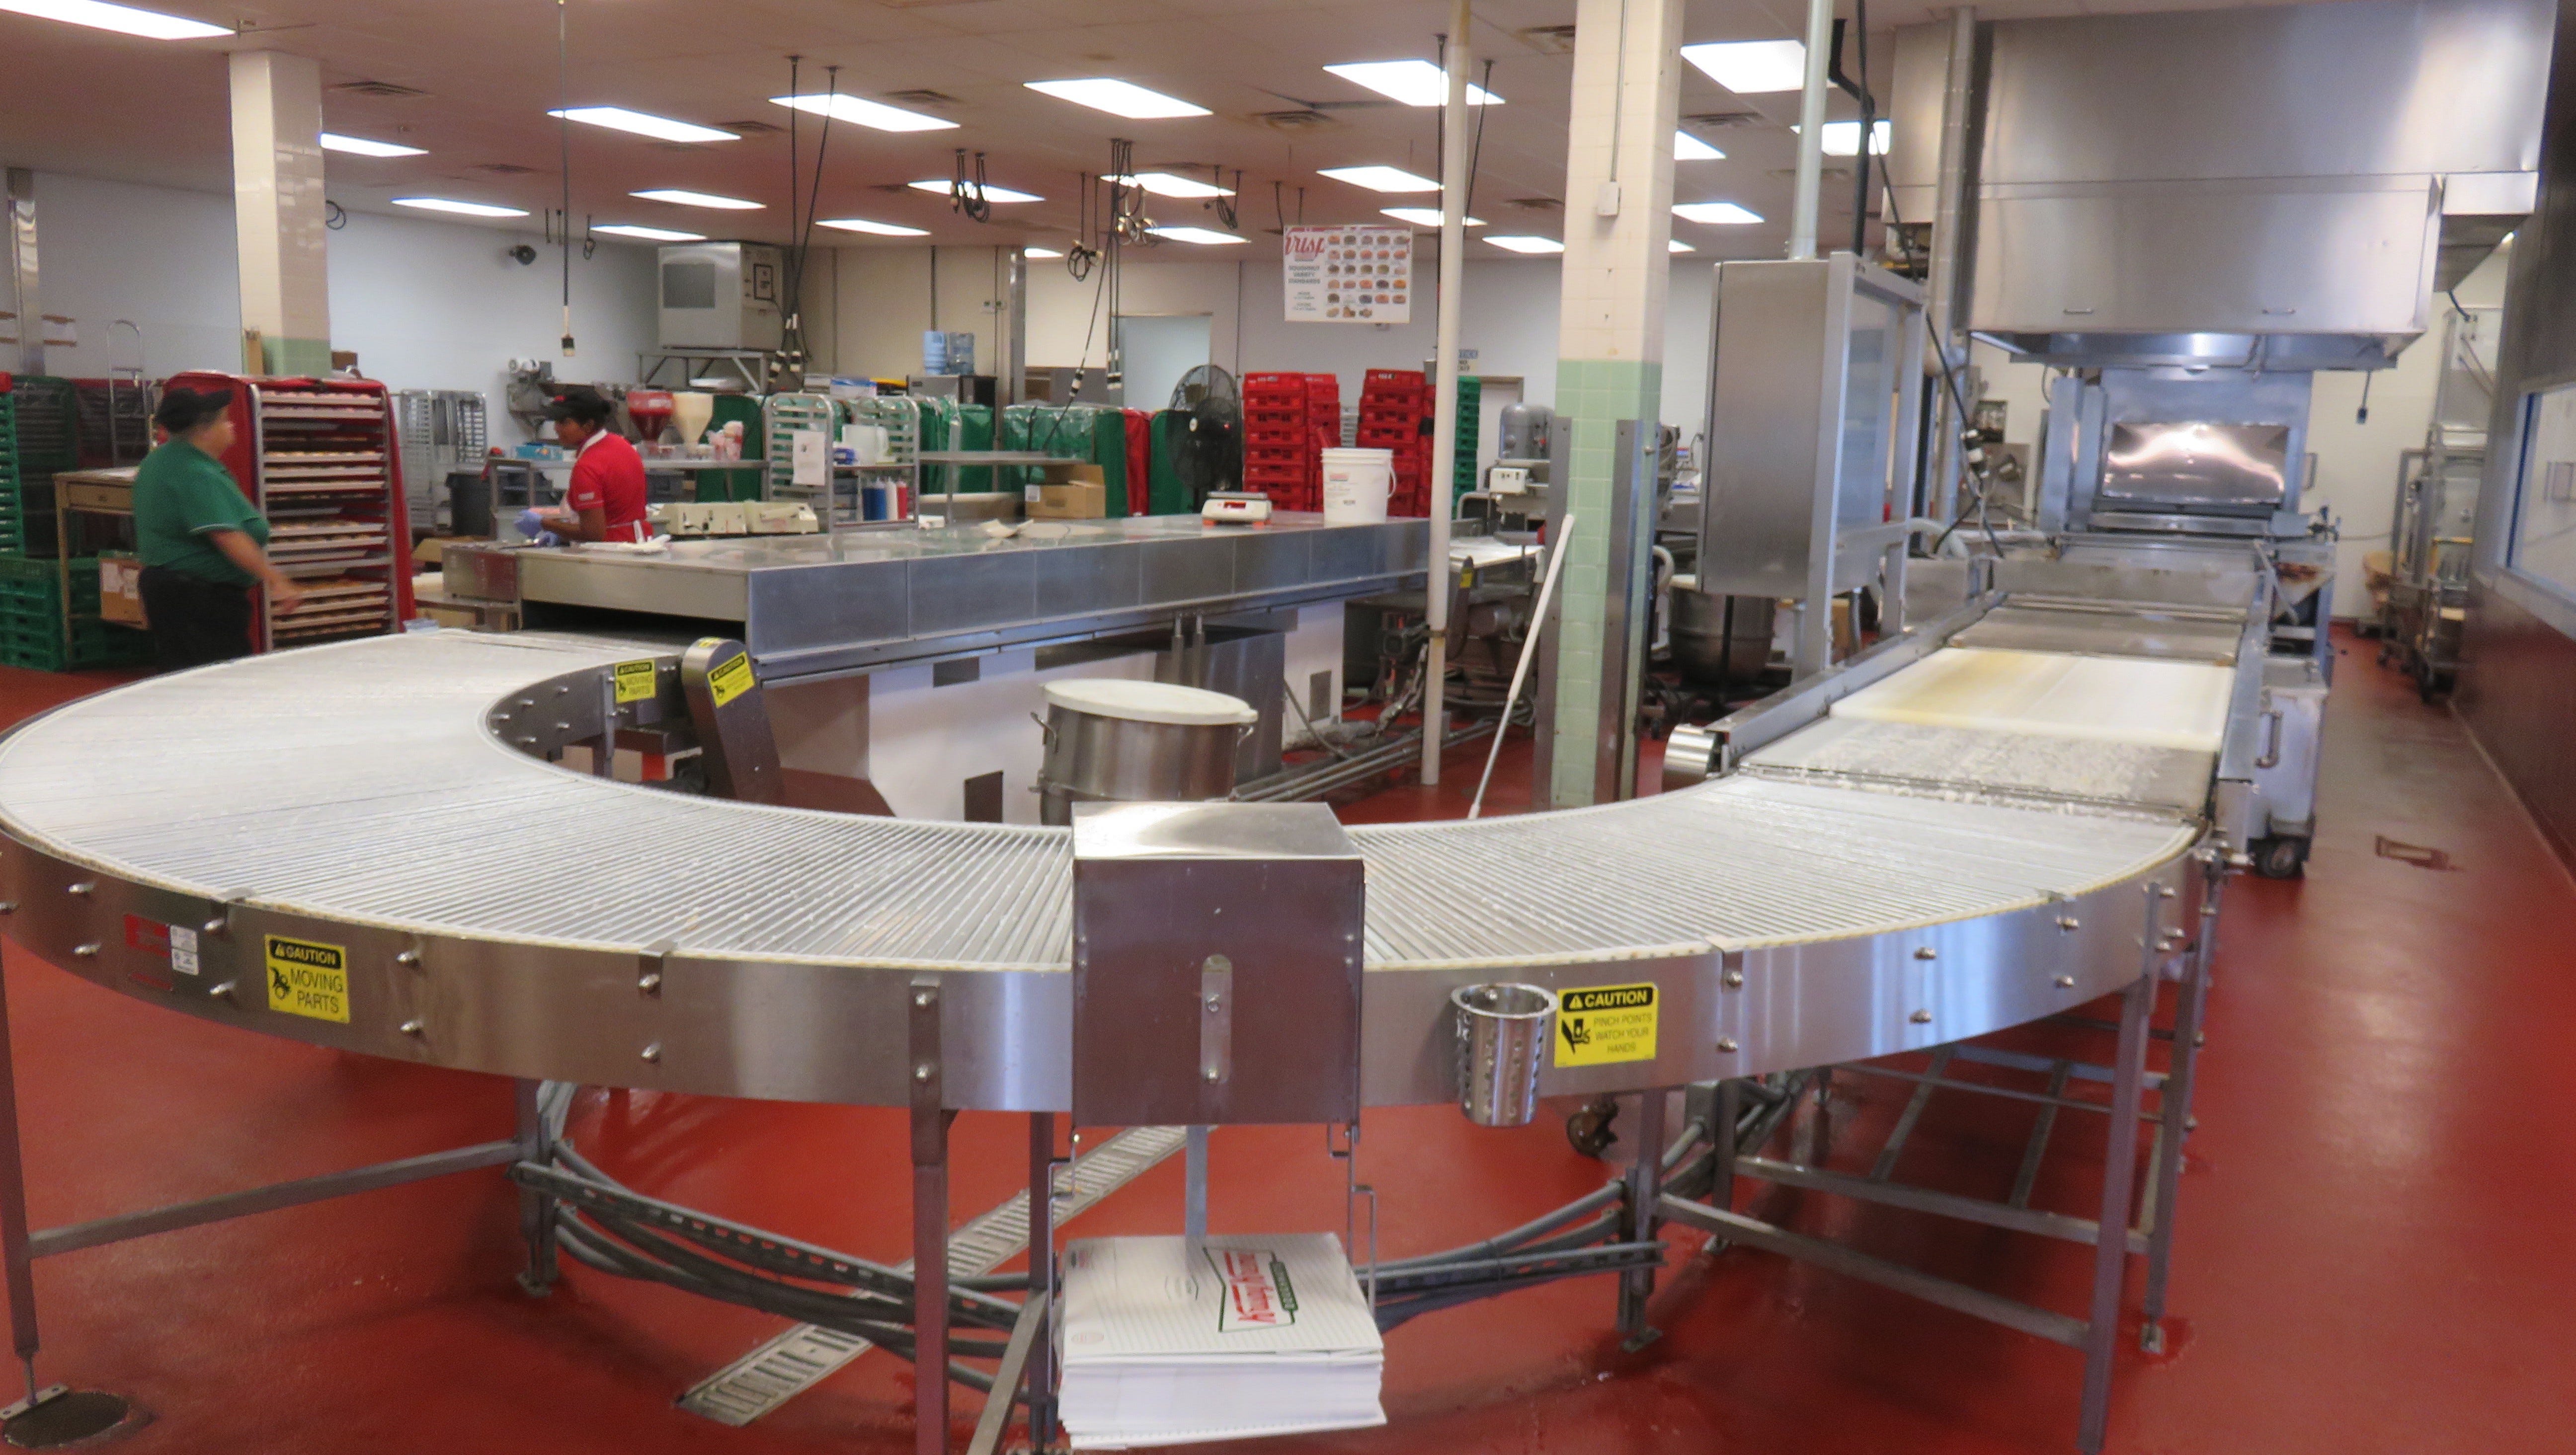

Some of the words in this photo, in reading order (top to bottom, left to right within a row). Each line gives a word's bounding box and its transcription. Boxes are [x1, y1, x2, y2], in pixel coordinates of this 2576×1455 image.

[285, 945, 336, 965] CAUTION
[291, 968, 343, 993] MOVING
[297, 990, 339, 1013] PARTS
[1585, 990, 1648, 1008] CAUTION
[1594, 1016, 1619, 1027] PINCH
[1622, 1013, 1652, 1024] POINTS
[1596, 1029, 1624, 1041] WATCH
[1626, 1026, 1649, 1038] YOUR
[1607, 1041, 1636, 1053] HANDS
